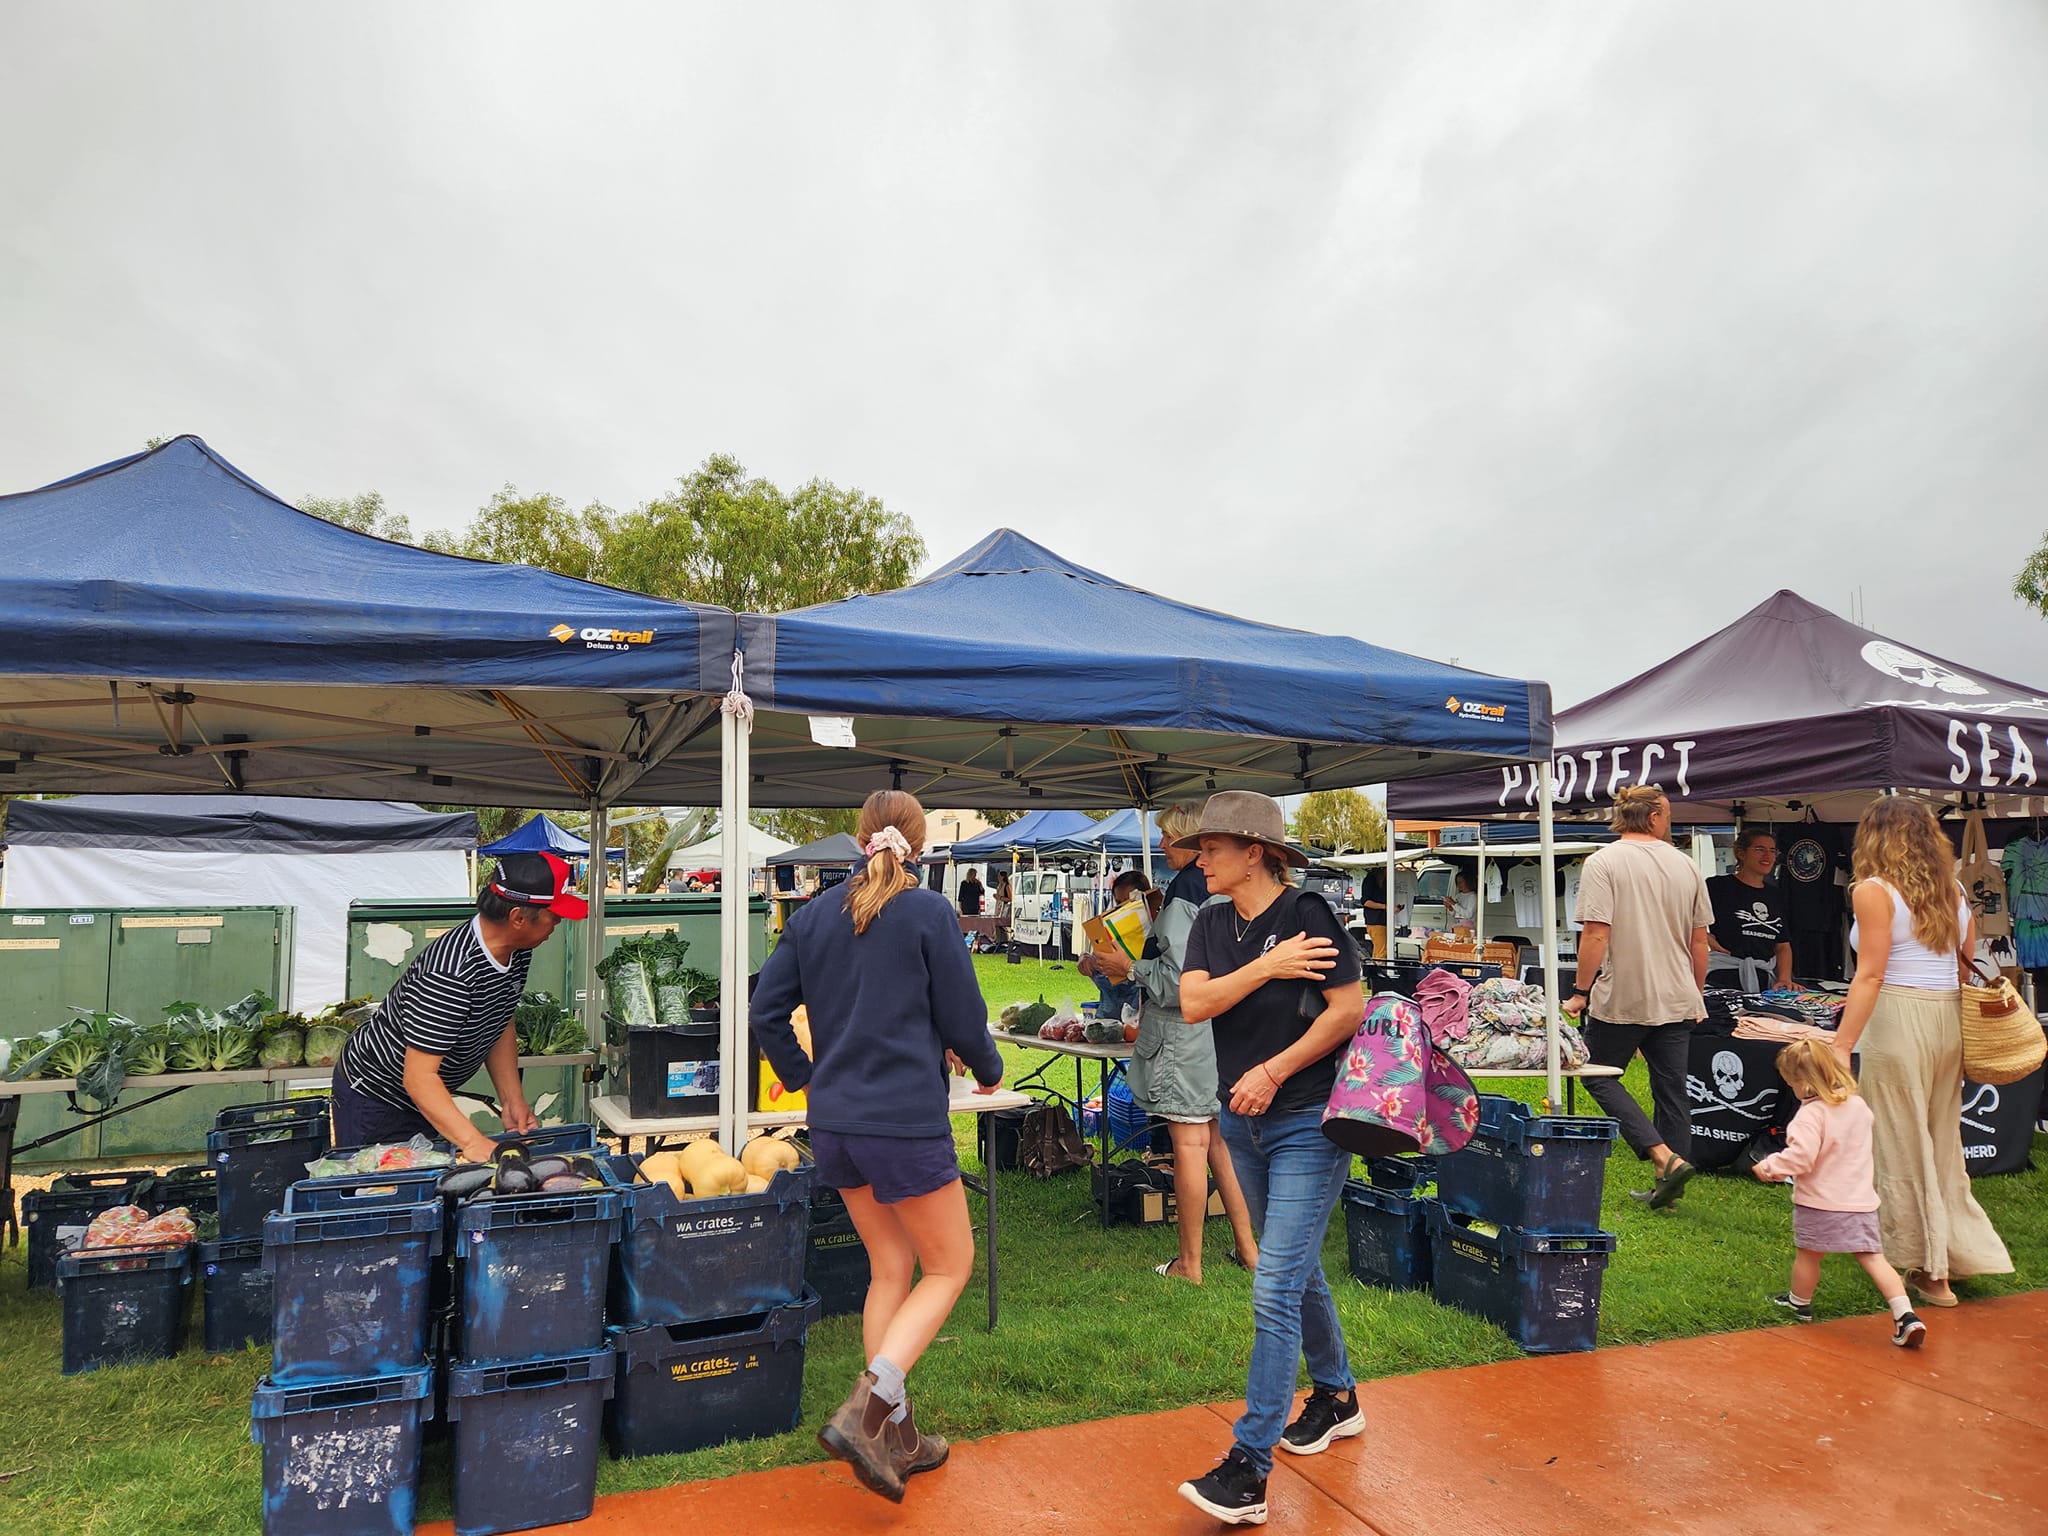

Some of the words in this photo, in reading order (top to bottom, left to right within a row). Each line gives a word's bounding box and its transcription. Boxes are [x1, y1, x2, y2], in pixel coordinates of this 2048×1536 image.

[587, 642, 615, 650] Deluxe
[616, 643, 630, 651] 3.0
[1948, 719, 2037, 787] SEA
[1357, 1018, 1405, 1039] CURL
[1690, 1124, 1712, 1138] SEA
[1712, 1128, 1750, 1142] SHEP
[1963, 1144, 1998, 1159] HERD
[676, 1222, 693, 1233] WA
[696, 1217, 735, 1231] crates
[814, 1237, 826, 1246] WA
[671, 1364, 688, 1375] WA
[691, 1357, 730, 1373] crates
